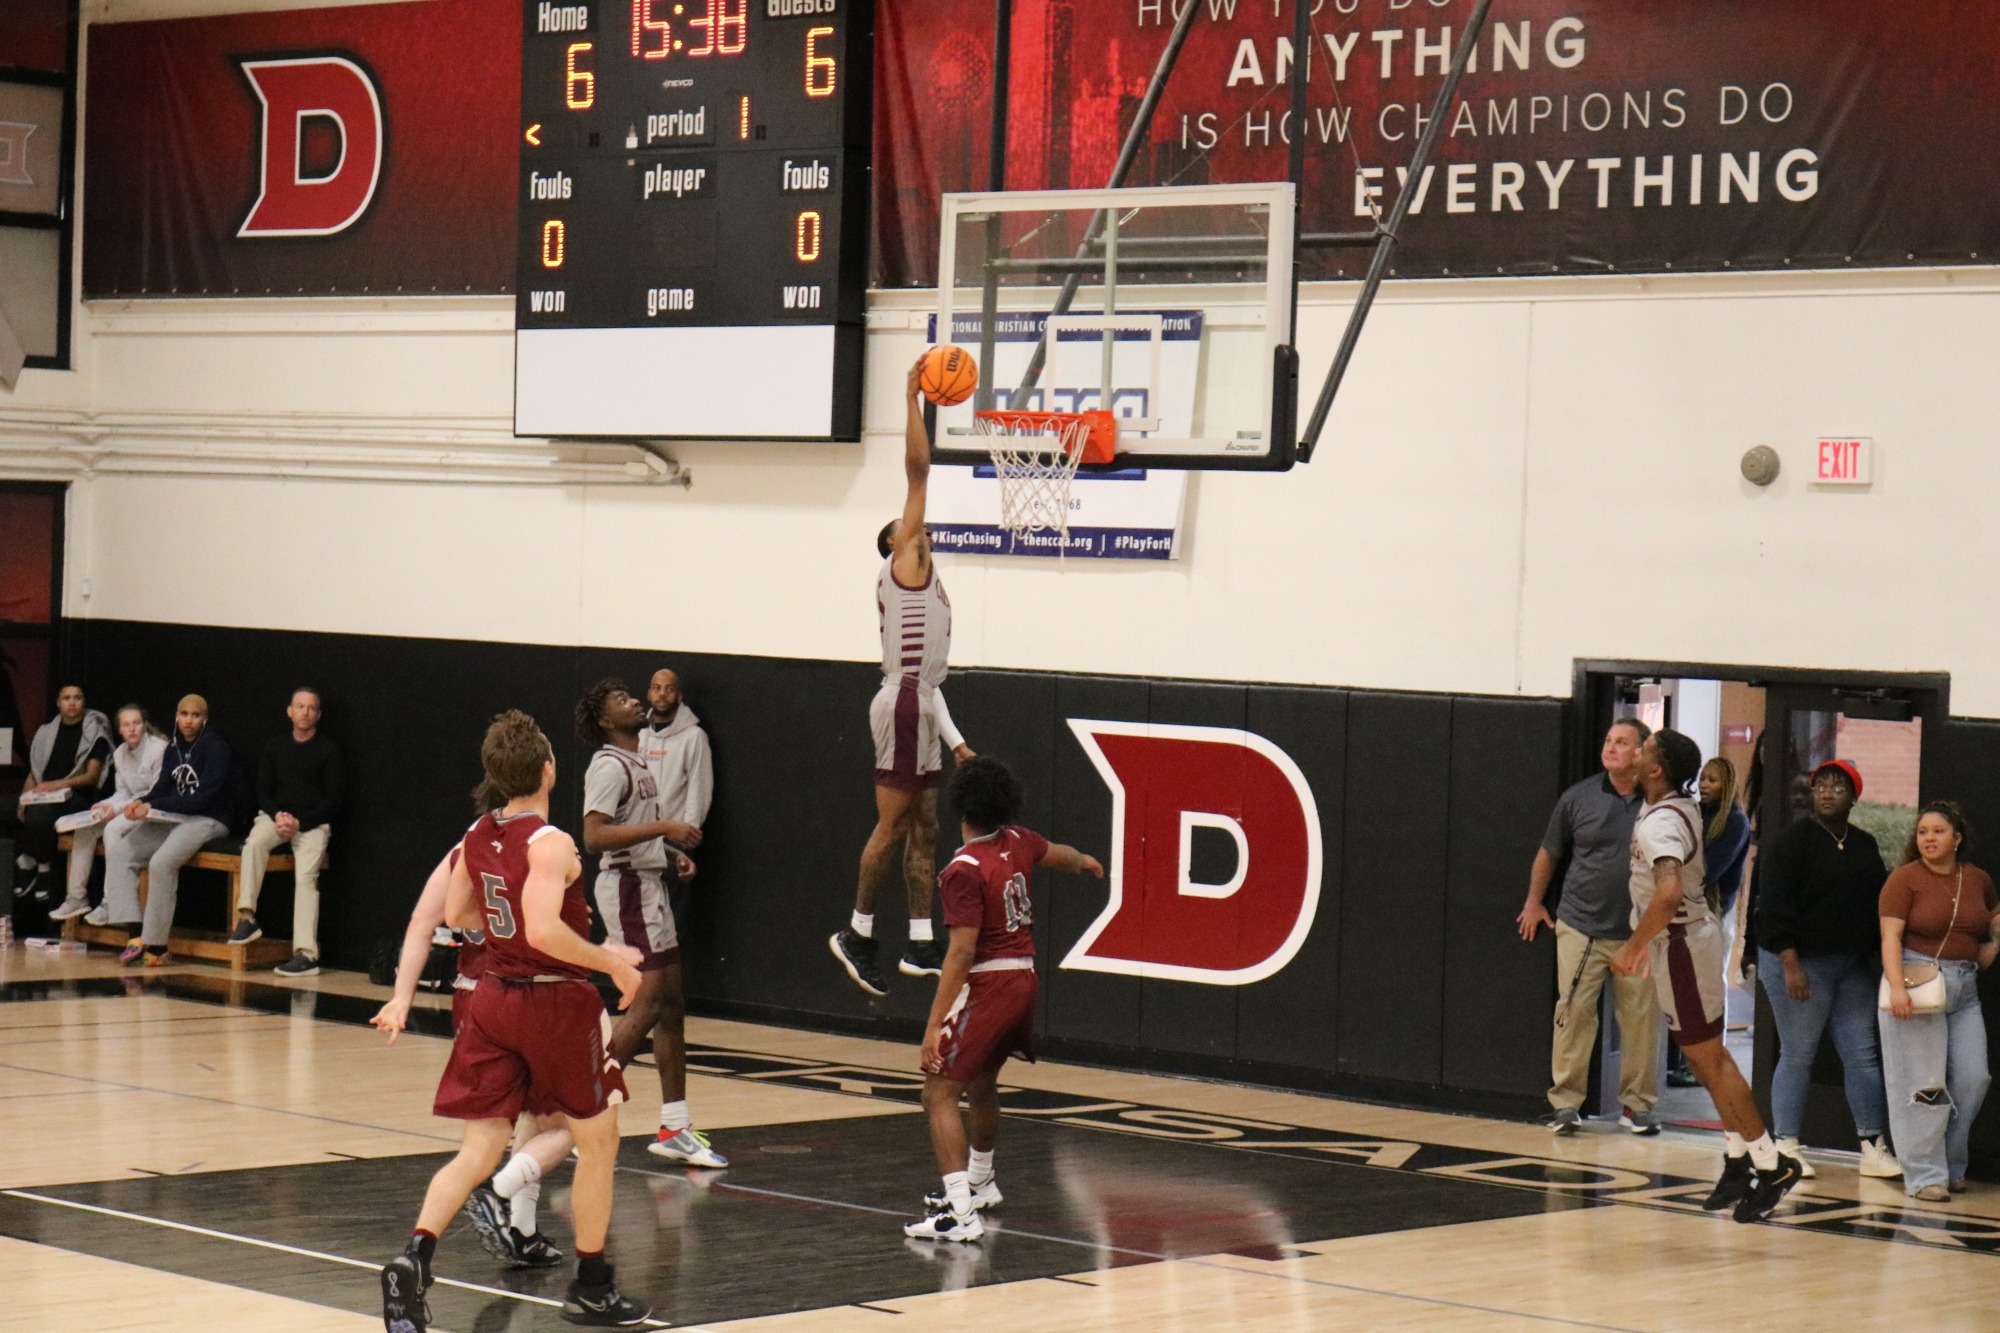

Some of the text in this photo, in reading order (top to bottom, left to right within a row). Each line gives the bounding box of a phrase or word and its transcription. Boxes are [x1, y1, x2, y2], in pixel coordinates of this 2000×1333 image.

[538, 3, 588, 32] Home
[632, 0, 747, 58] 15:38
[566, 42, 594, 109] 6
[806, 26, 836, 96] 6
[647, 105, 705, 144] period
[1182, 113, 1218, 149] IS
[1720, 82, 1794, 125] DO
[531, 171, 572, 200] fouls
[644, 163, 706, 200] player
[783, 160, 830, 190] fouls
[1354, 148, 1819, 216] EVERYTHING
[543, 219, 564, 267] 0
[798, 211, 820, 261] 0
[531, 290, 565, 312] won
[648, 287, 694, 316] game
[783, 285, 821, 309] won
[1818, 441, 1860, 479] EXIT
[932, 530, 1002, 548] #KingChasing
[1024, 532, 1093, 551] thenccaa.org
[481, 872, 516, 939] 5
